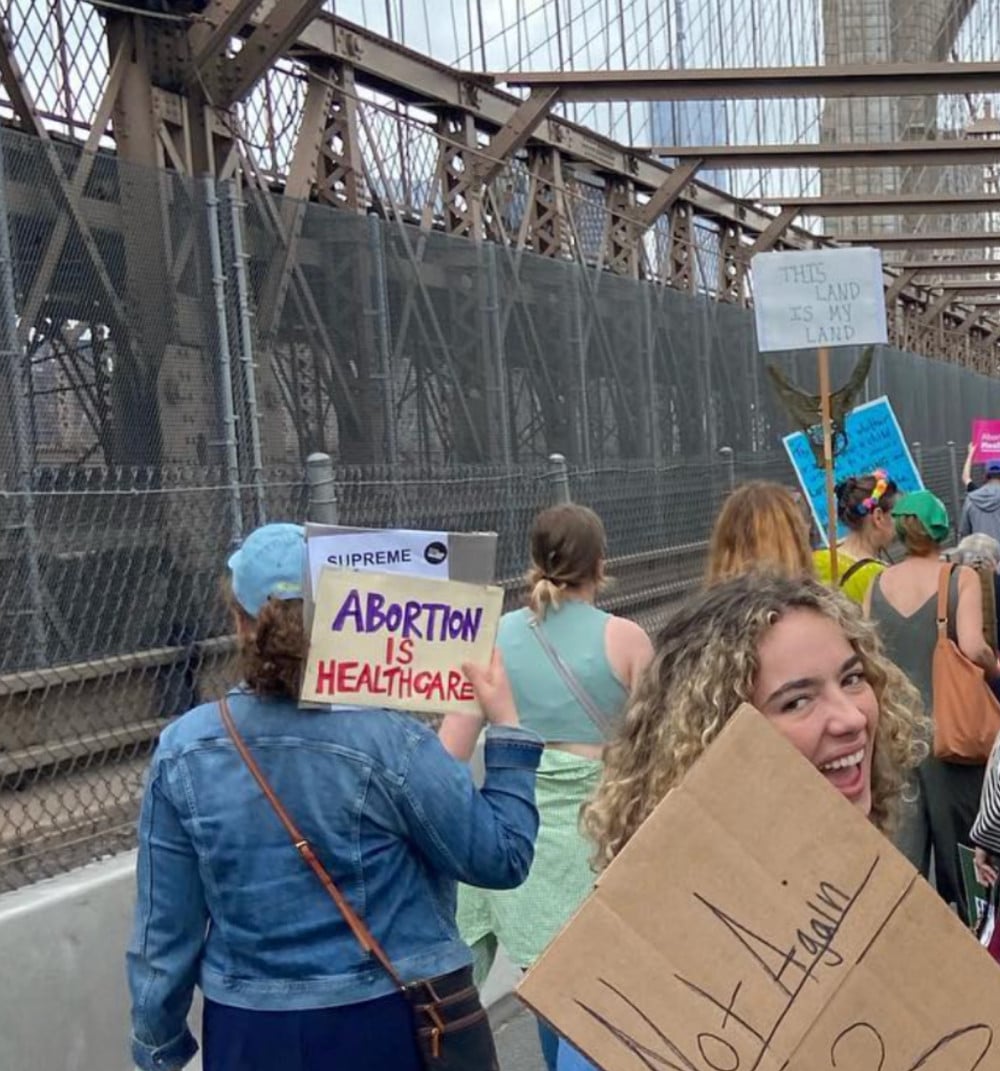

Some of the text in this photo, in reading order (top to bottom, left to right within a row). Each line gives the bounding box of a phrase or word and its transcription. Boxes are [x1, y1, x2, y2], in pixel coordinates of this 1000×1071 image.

[780, 262, 827, 284] THIS
[815, 282, 860, 301] LAND
[788, 303, 852, 322] IS MY
[805, 325, 855, 343] LAND
[327, 549, 412, 567] SUPREME
[331, 589, 483, 642] ABORTION
[386, 637, 414, 665] IS
[315, 659, 475, 701] HEALTHCARE
[693, 879, 852, 1000] Again
